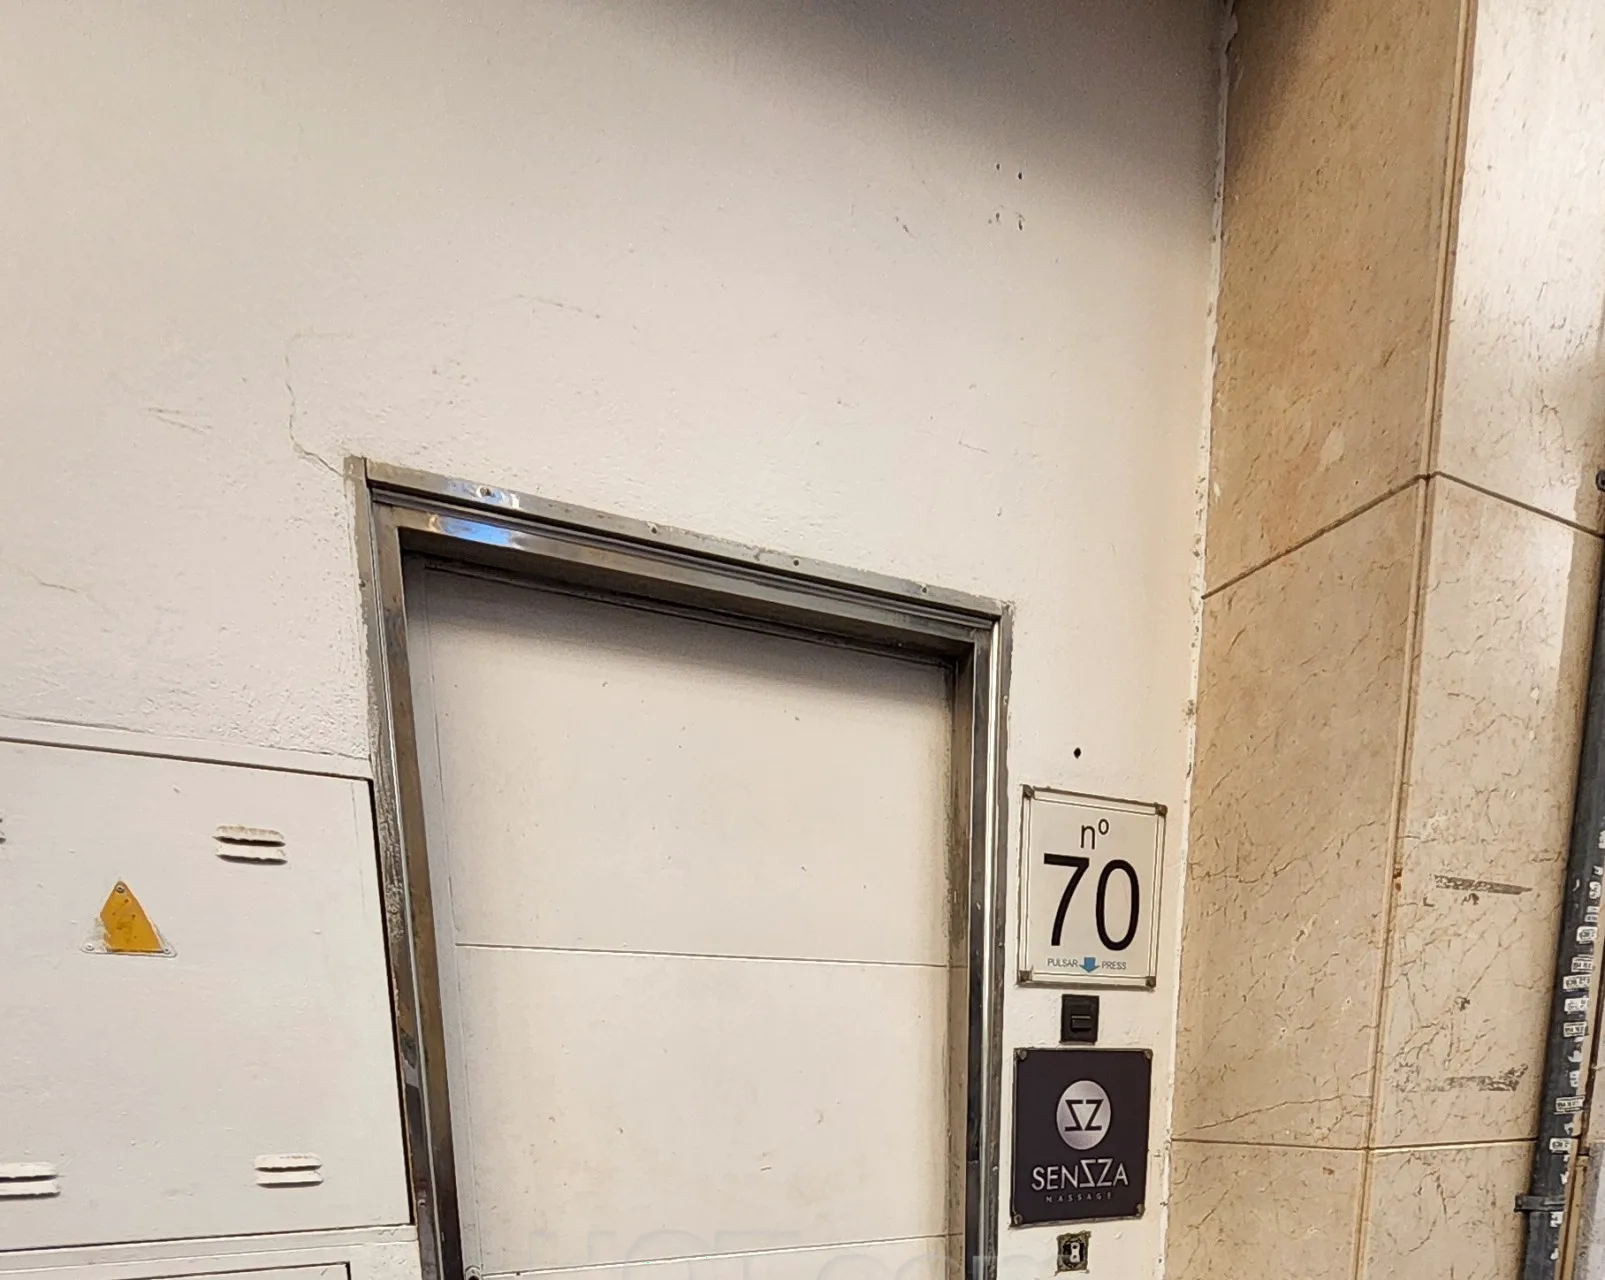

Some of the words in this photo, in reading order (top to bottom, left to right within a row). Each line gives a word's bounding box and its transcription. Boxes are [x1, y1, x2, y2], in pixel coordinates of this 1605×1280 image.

[1043, 853, 1140, 951] 70
[1047, 958, 1078, 967] PULSAR
[1101, 961, 1127, 970] PRESS
[1031, 1158, 1128, 1191] SENZZA
[1045, 1192, 1112, 1203] MASSAGE
